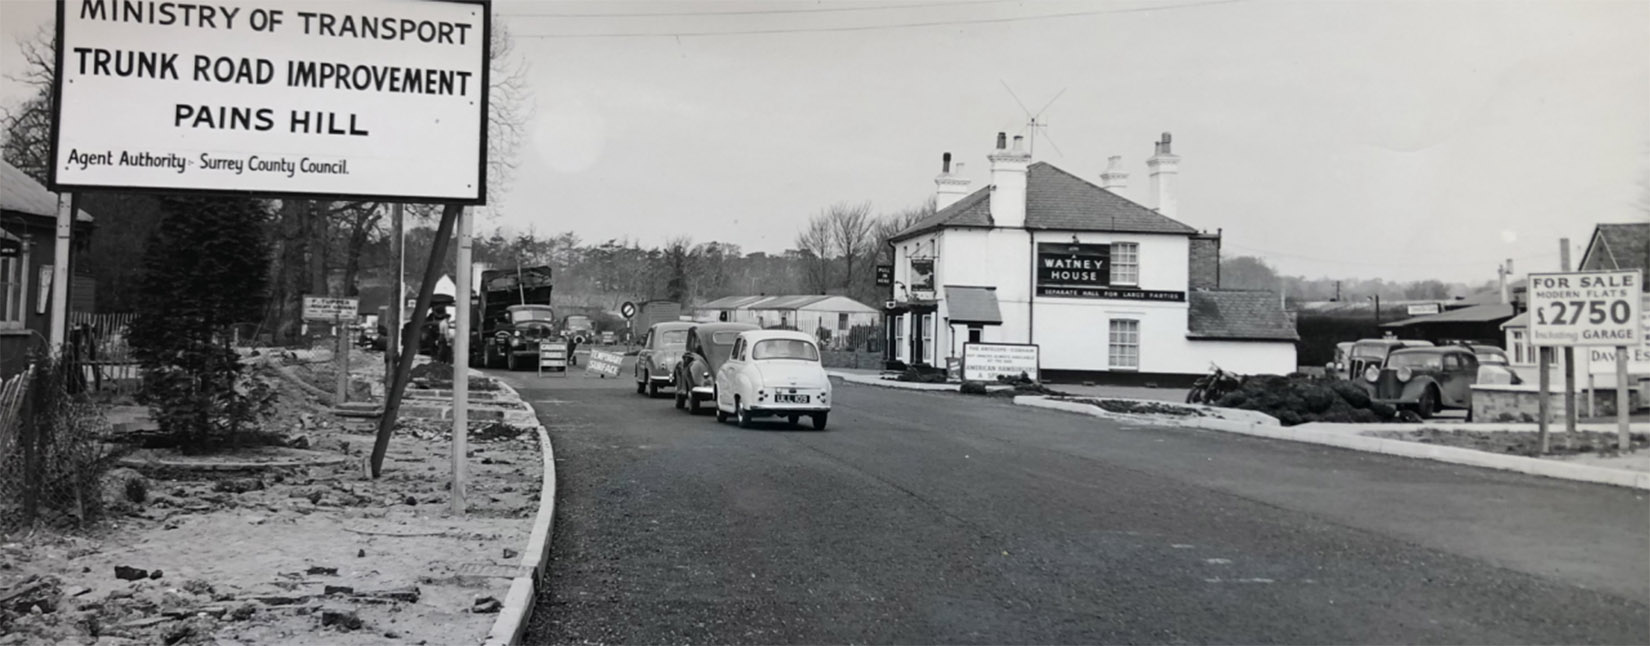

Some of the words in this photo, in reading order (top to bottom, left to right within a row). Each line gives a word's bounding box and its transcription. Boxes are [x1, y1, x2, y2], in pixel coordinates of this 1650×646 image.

[80, 0, 240, 31] MINISTRY
[249, 8, 284, 32] OF
[298, 12, 472, 45] TRANSPORT
[73, 47, 179, 80] TRUNK
[193, 55, 274, 84] ROAD
[287, 60, 472, 96] IMPROVEMENT
[174, 104, 275, 131] PAINS
[291, 111, 369, 136] HILL
[67, 148, 113, 170] Agent
[200, 153, 244, 175] Surrey
[248, 156, 295, 178] County
[1044, 259, 1103, 269] WATNEY
[1051, 271, 1097, 280] HOUSE
[1533, 278, 1570, 289] FOR
[1580, 275, 1634, 288] SALE
[1536, 290, 1580, 299] MODERN
[1586, 289, 1627, 298] FLATS
[1537, 299, 1631, 325] £2750
[1535, 330, 1578, 341] Including
[1583, 329, 1633, 339] GARAGE
[1591, 350, 1629, 361] DAVS
